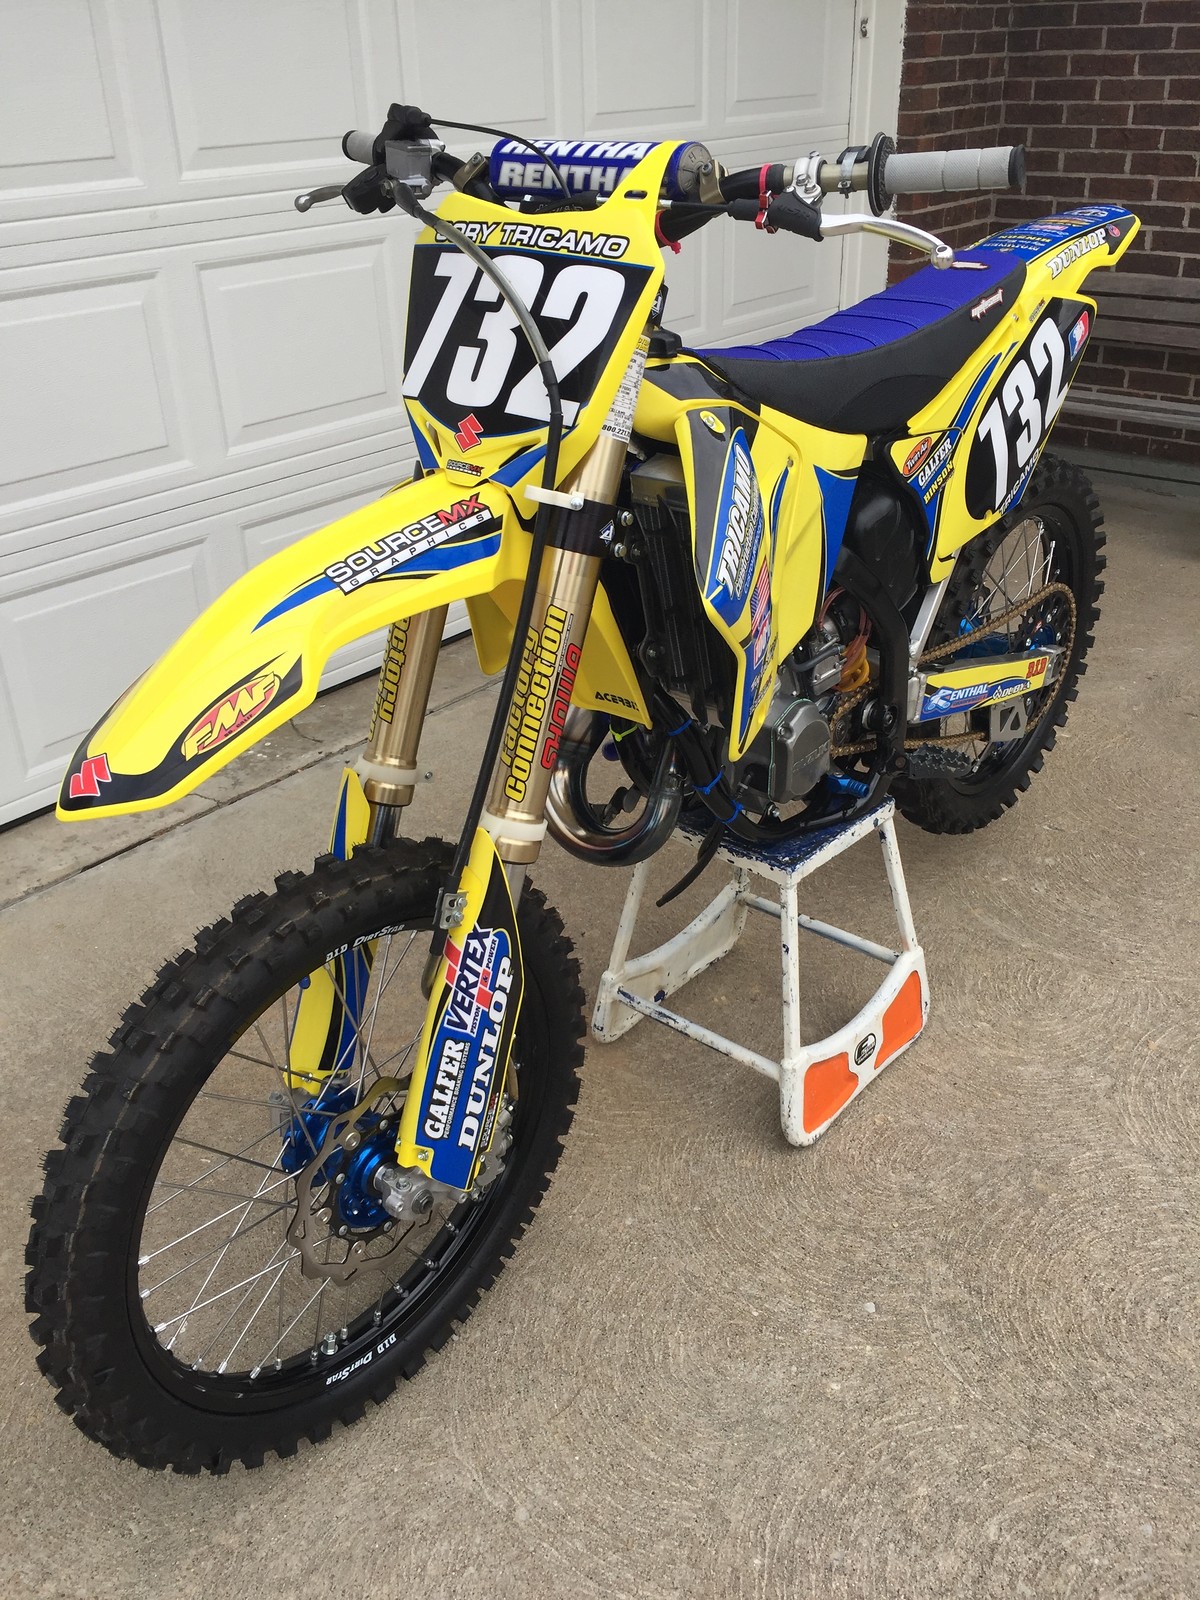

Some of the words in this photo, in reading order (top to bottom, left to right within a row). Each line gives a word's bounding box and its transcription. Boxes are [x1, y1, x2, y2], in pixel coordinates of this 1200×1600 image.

[498, 160, 634, 192] RENTH
[499, 140, 653, 160] RENTHA
[500, 222, 630, 259] TRICAMO
[1046, 227, 1108, 280] DUNLOP
[402, 252, 625, 427] 732
[978, 317, 1069, 510] 732
[918, 437, 952, 487] GALFER
[923, 460, 955, 505] HINSON
[999, 447, 1041, 515] TRICAMO
[325, 492, 488, 584] SOURCEMX
[349, 513, 485, 587] GRAPHICS
[716, 443, 752, 599] TRICAMO
[184, 671, 275, 761] FMF
[504, 604, 568, 803] connection
[446, 925, 491, 1031] VERTEX
[470, 1004, 481, 1035] PISTON
[486, 938, 498, 971] POWER
[425, 1039, 465, 1140] GALFER
[443, 1095, 458, 1139] PERFORMANCE
[454, 1068, 465, 1096] BRAKING
[460, 1042, 471, 1069] SYSTEMS
[458, 956, 514, 1151] DUNLOP
